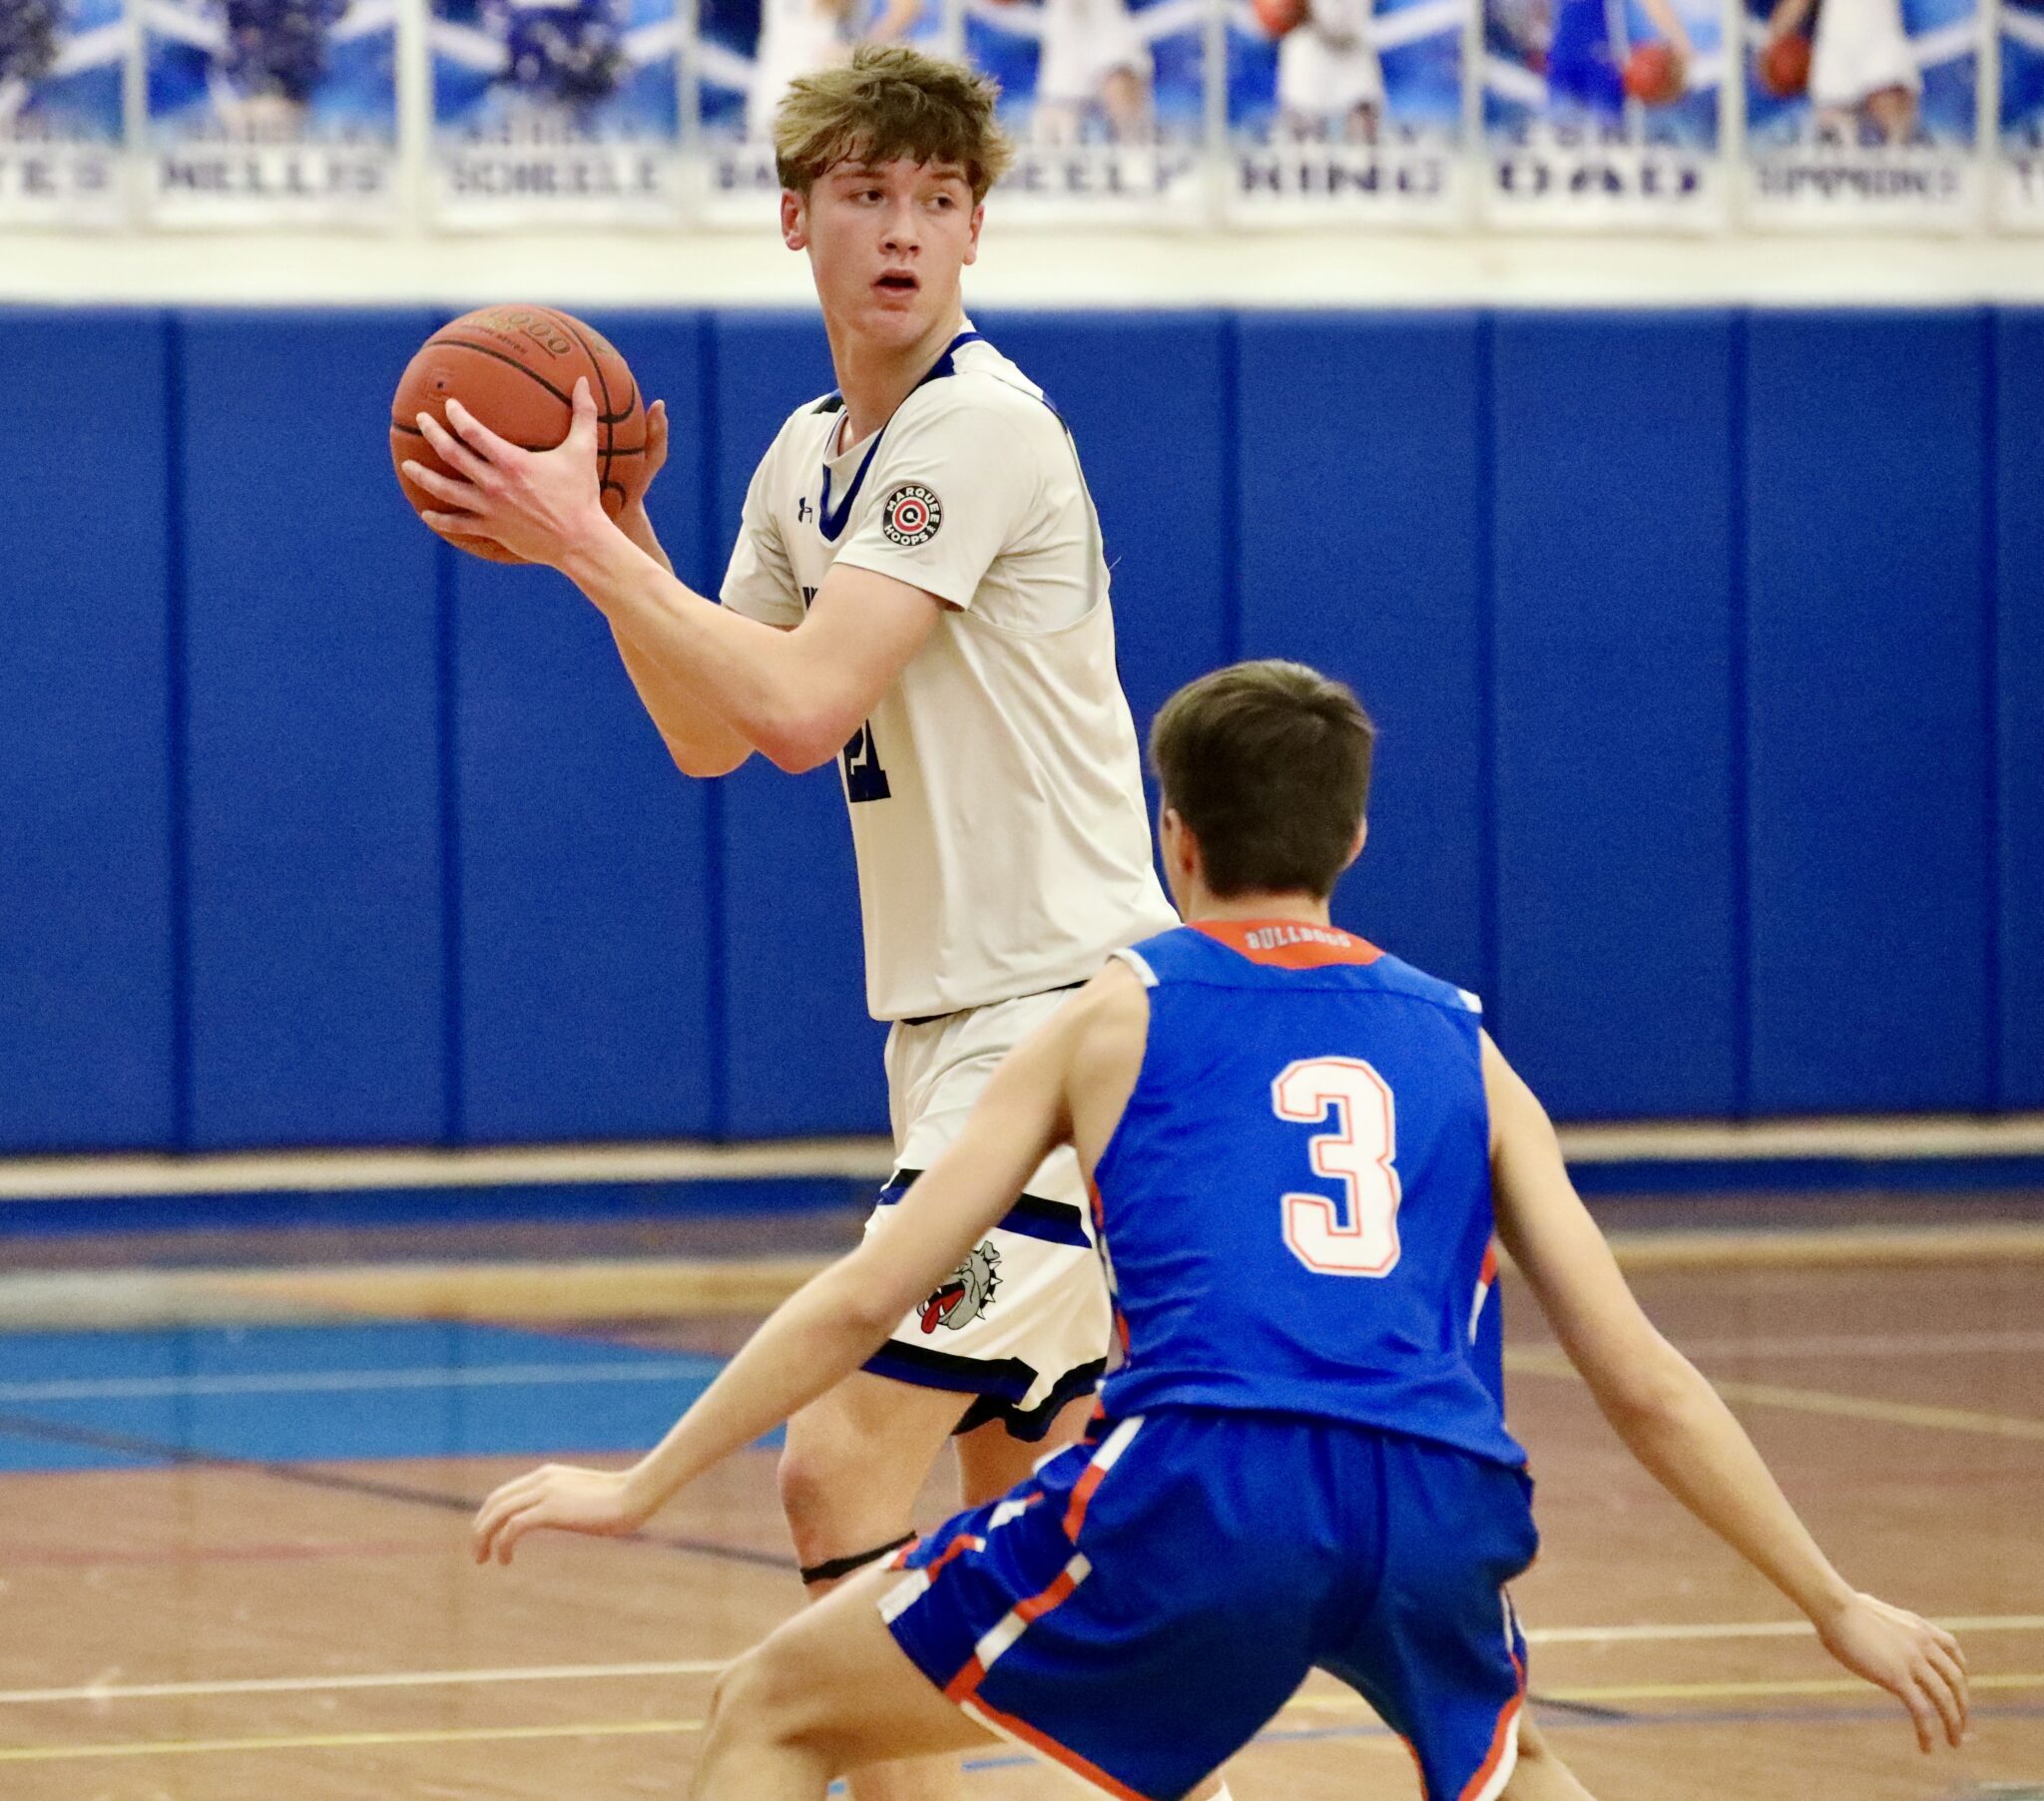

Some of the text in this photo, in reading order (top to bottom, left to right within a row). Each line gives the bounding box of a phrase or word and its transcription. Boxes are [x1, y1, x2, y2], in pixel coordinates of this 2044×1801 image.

[1240, 158, 1442, 197] KING
[886, 487, 940, 523] MARQUEE
[883, 524, 929, 546] HOOPS
[1271, 1056, 1402, 1278] 3
